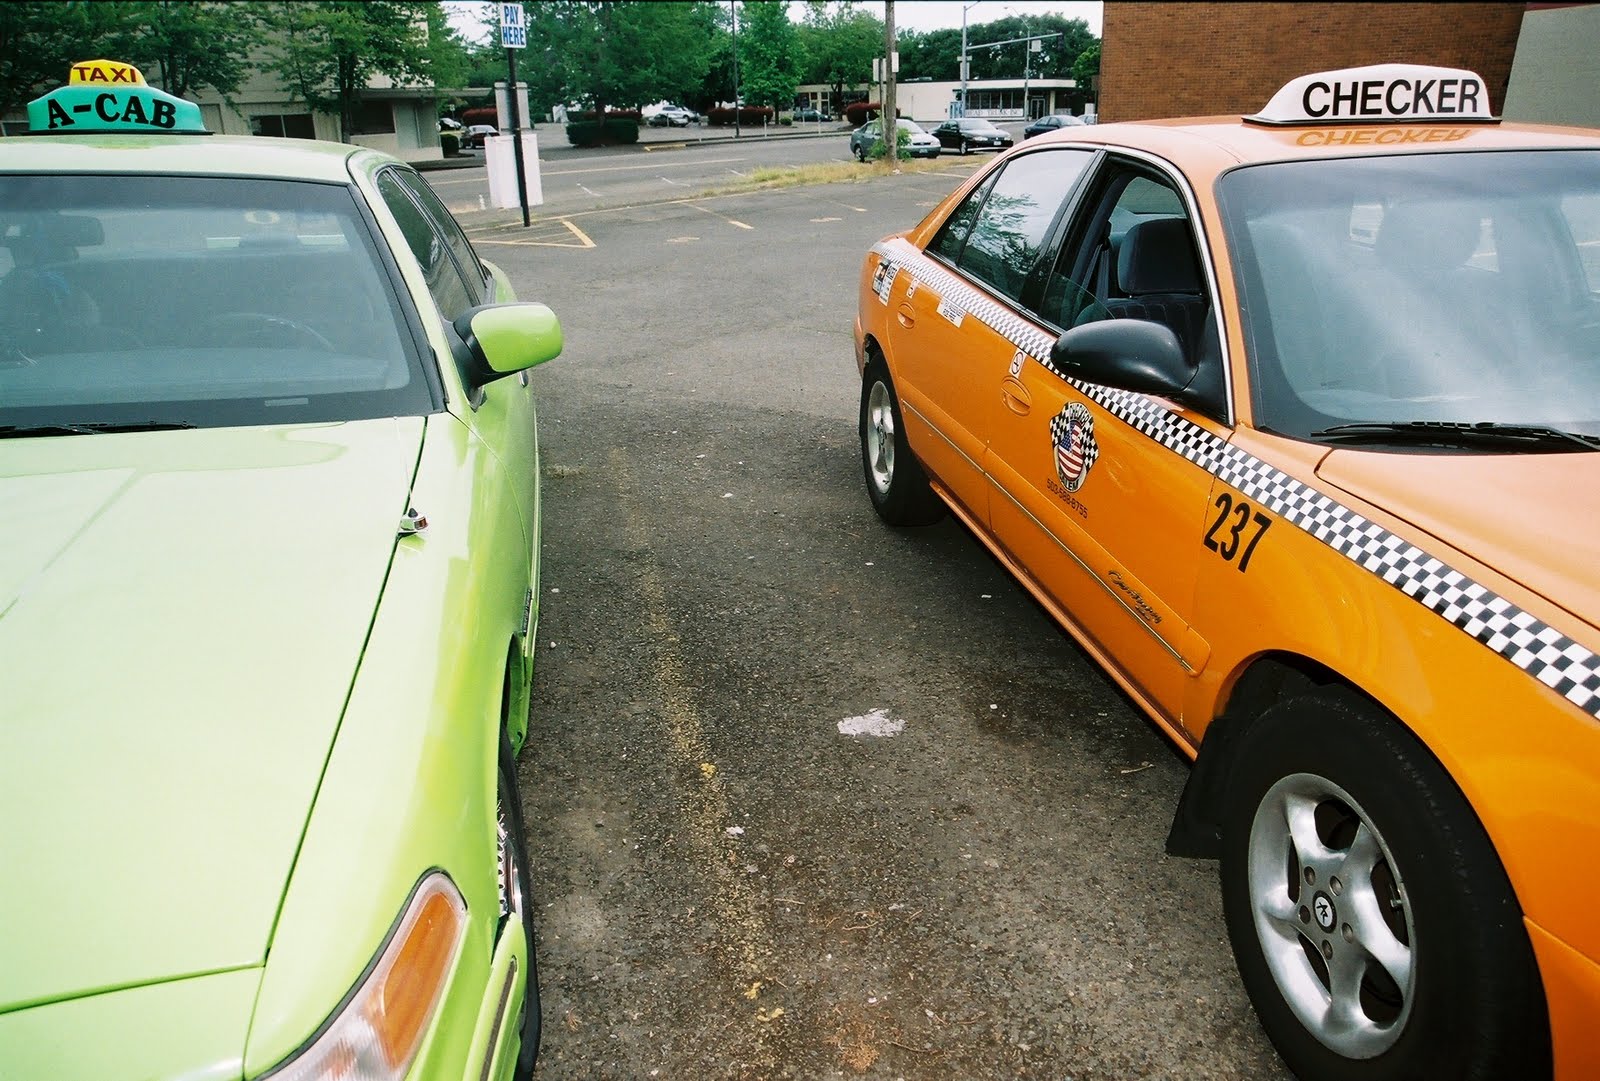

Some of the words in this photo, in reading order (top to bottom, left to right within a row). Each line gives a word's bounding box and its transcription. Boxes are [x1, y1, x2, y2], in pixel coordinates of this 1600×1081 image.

[504, 5, 519, 25] PAY
[502, 26, 525, 46] HERE
[73, 66, 137, 83] TAXI
[47, 93, 177, 129] A-CAB
[1302, 79, 1480, 118] CHECKER
[1203, 492, 1273, 574] 237
